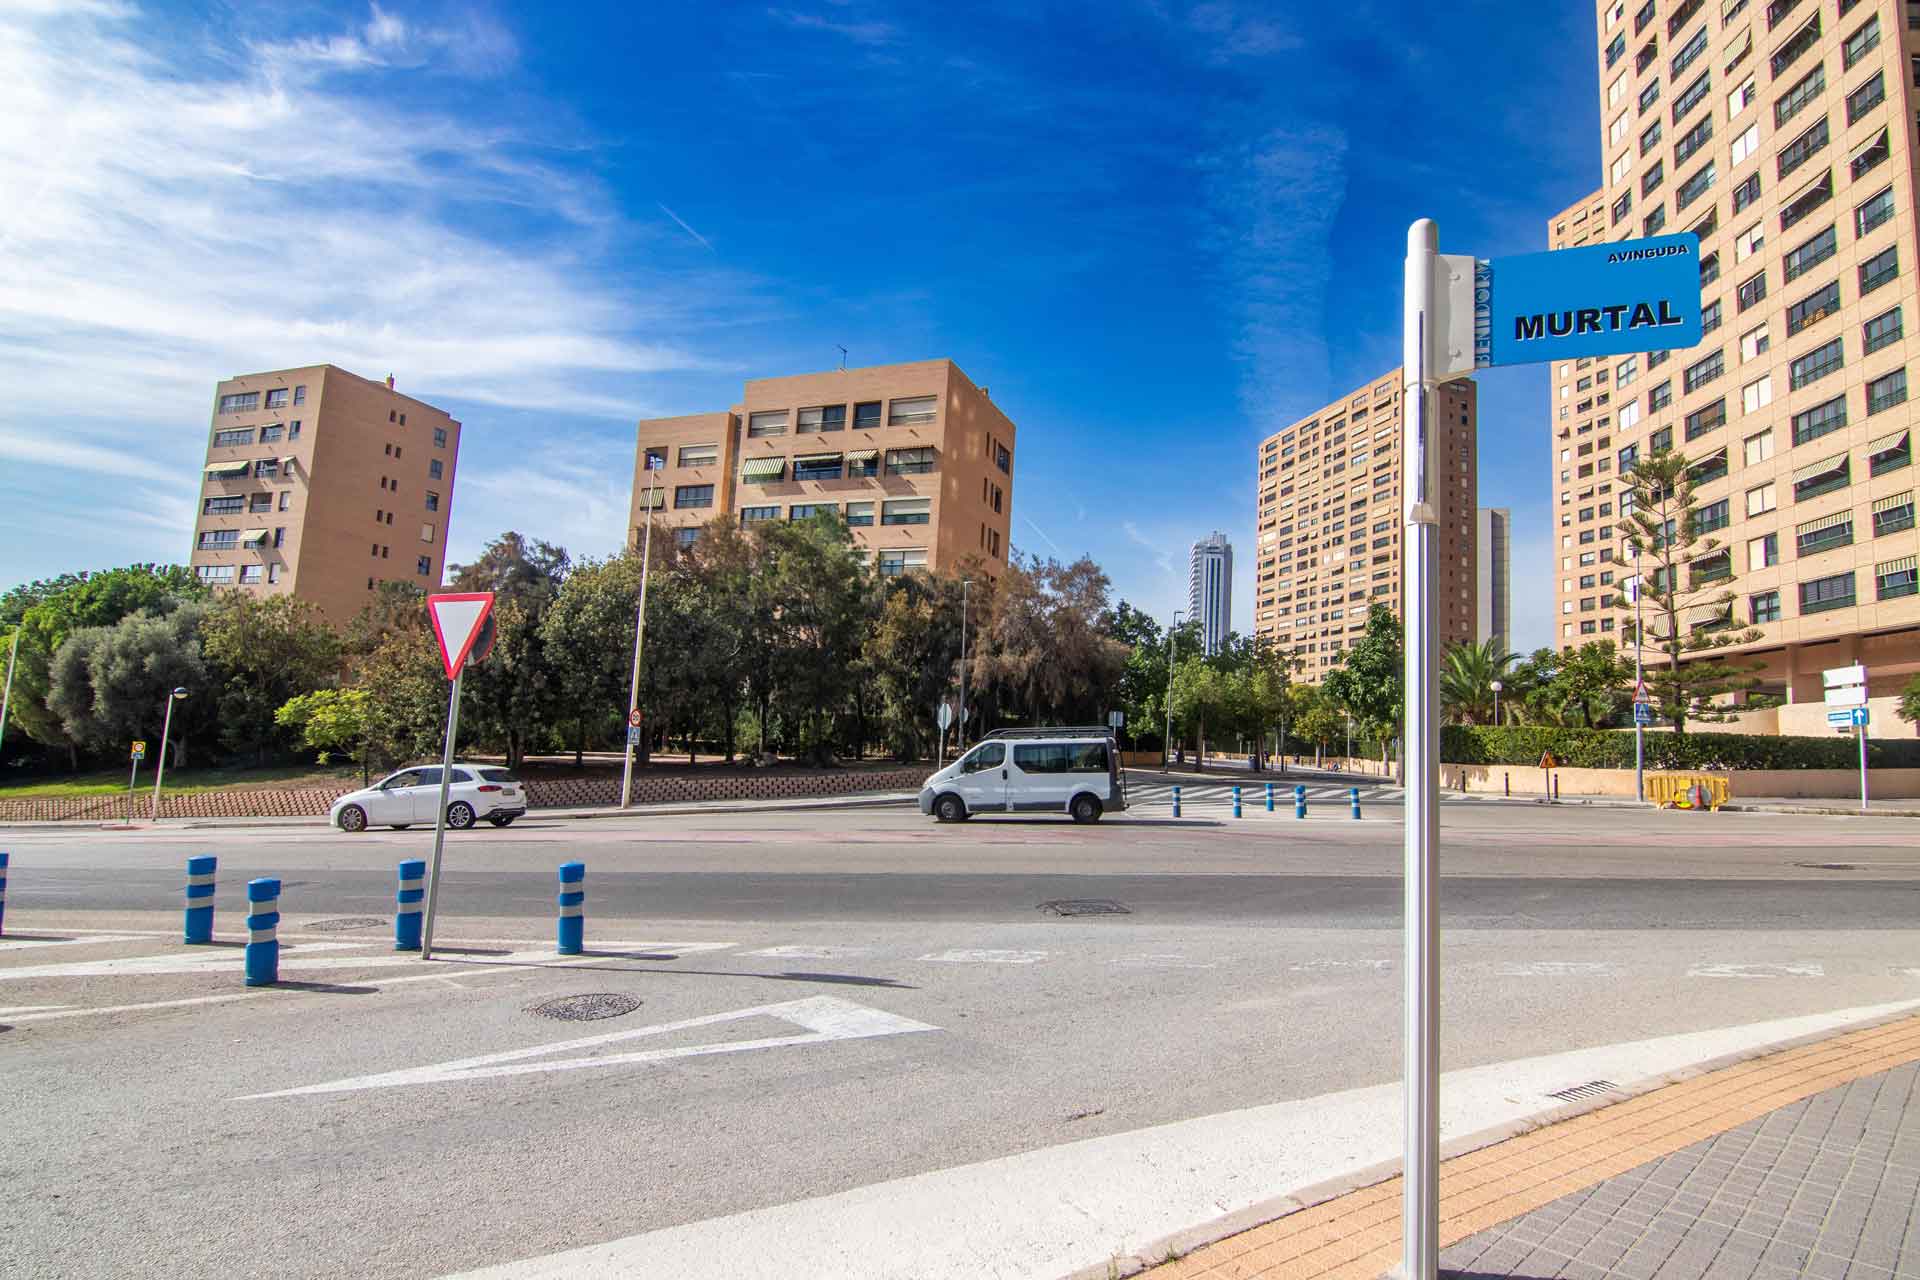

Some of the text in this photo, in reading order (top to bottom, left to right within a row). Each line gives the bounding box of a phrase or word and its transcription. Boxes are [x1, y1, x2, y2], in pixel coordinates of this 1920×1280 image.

[1608, 244, 1689, 263] AVINGUDA
[1475, 258, 1490, 367] BENIDORM
[1515, 300, 1683, 341] MURTAL
